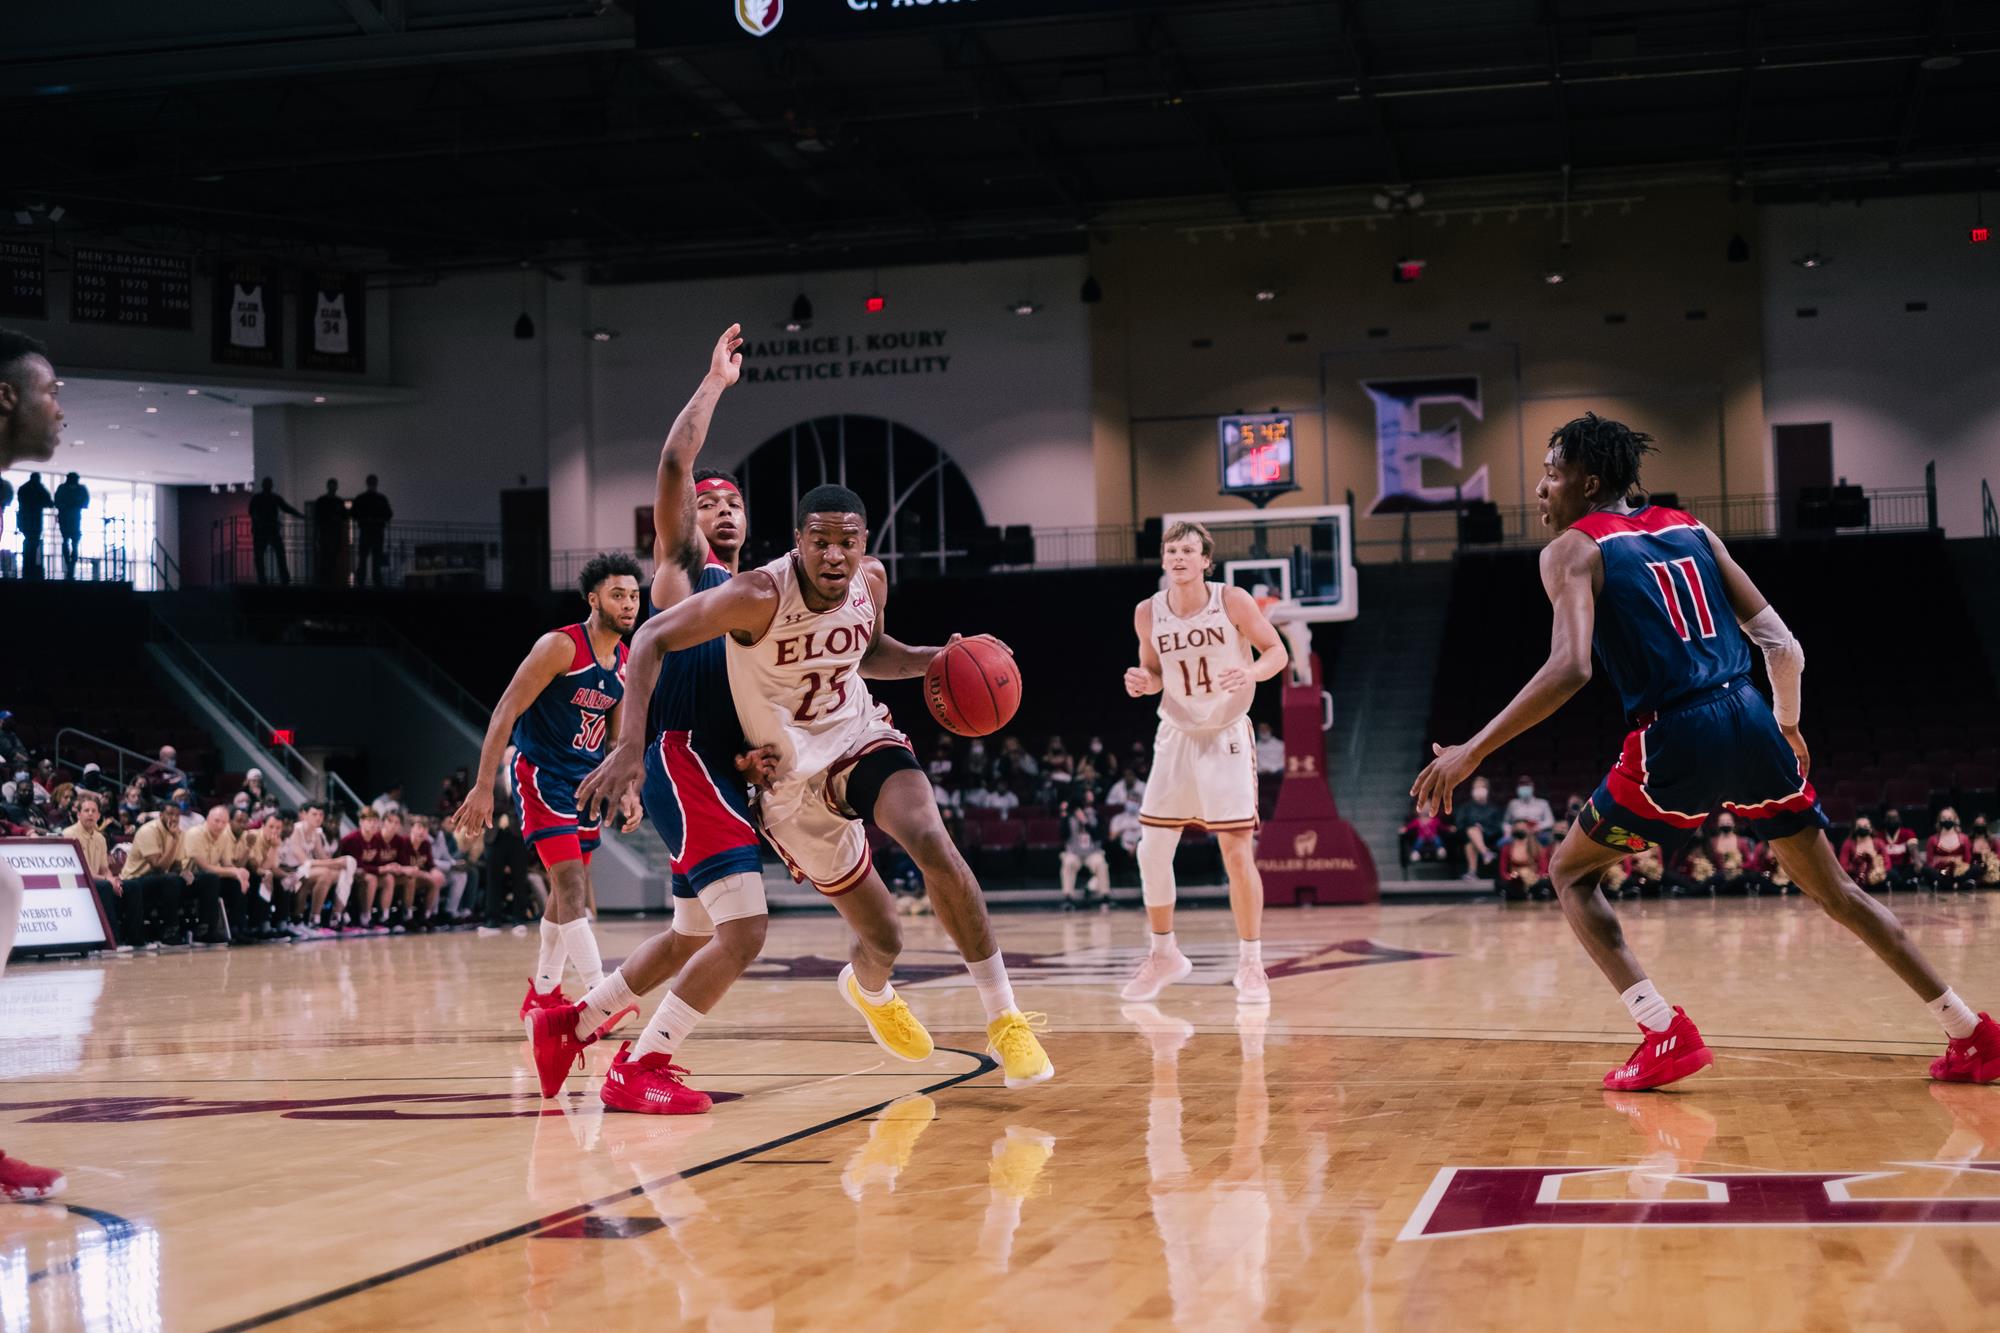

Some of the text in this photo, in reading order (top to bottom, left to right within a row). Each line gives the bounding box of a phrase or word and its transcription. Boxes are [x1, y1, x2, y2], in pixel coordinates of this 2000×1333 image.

[77, 250, 187, 270] MEN'S BASKETBALL
[13, 286, 43, 297] 1974
[77, 275, 190, 293] 1965 1970 1971
[77, 290, 191, 310] 1972 1980 1986
[77, 306, 149, 322] 1997 2013
[239, 313, 257, 328] 40
[322, 320, 340, 334] 34
[846, 335, 861, 355] J.
[866, 330, 947, 351] KOURY
[848, 355, 950, 377] FACILITY
[1249, 445, 1281, 481] 16
[1646, 556, 1718, 642] 11
[774, 620, 873, 667] ELON
[1157, 626, 1225, 655] ELON
[1178, 656, 1213, 697] 14
[793, 664, 851, 721] 25
[572, 709, 606, 752] 30
[1230, 742, 1241, 755] E
[1306, 857, 1358, 870] DENTAL
[61, 906, 73, 918] OF
